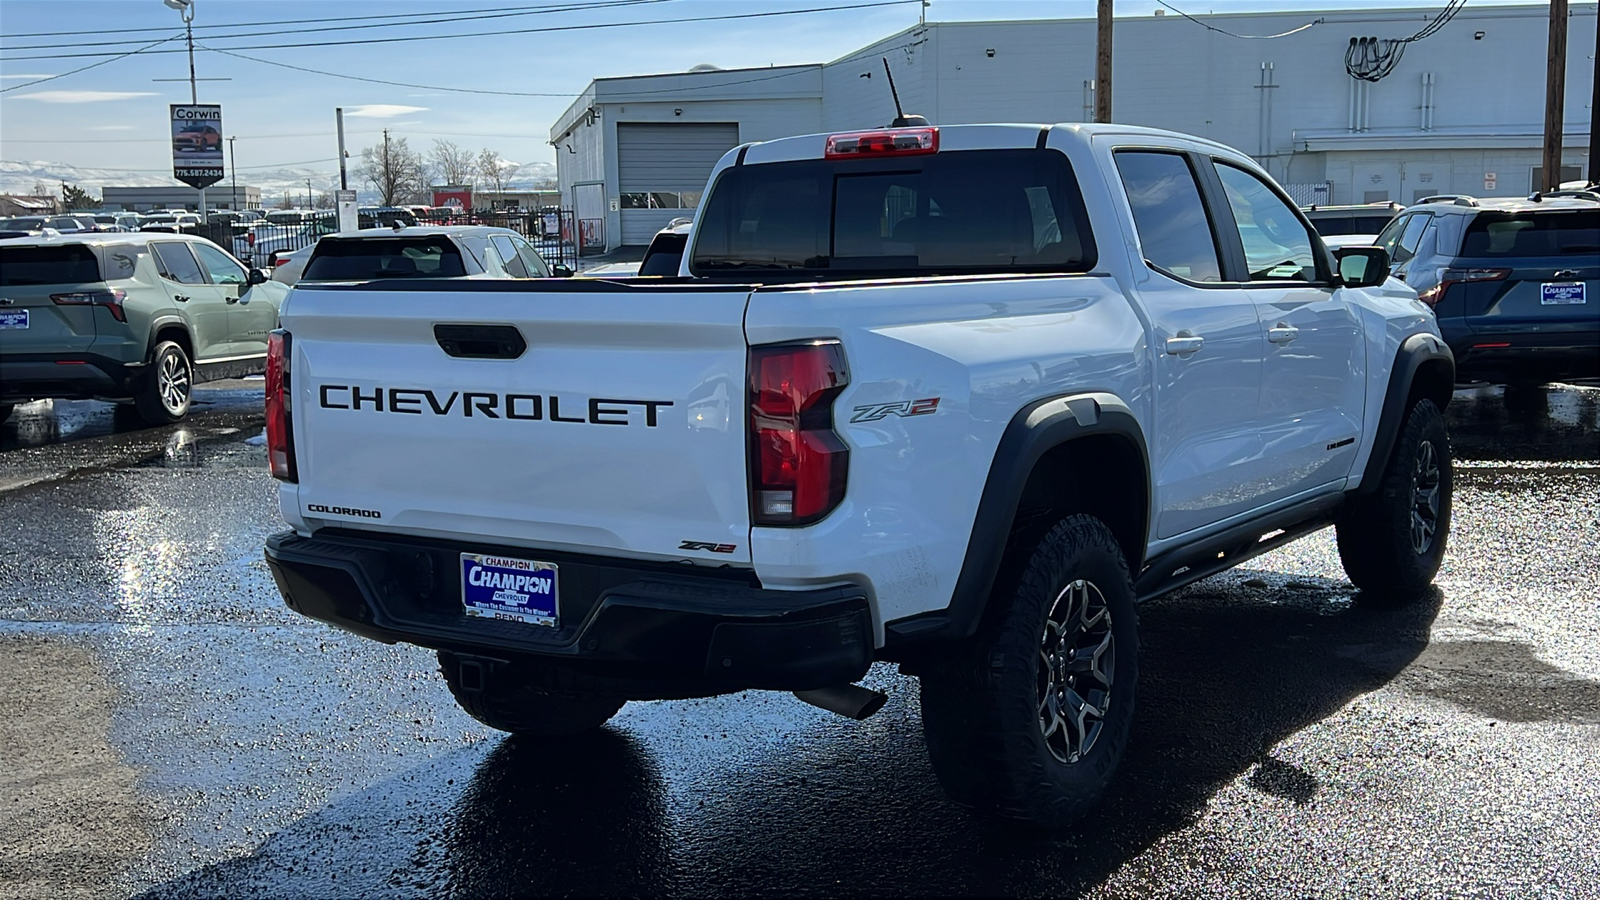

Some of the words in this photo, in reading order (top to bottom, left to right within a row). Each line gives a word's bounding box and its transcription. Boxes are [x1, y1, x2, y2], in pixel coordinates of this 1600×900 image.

[176, 108, 220, 119] Corwin
[319, 384, 674, 427] CHEVROLET
[849, 397, 941, 423] ZR2
[307, 504, 382, 518] COLORADO
[678, 540, 737, 553] ZR2
[485, 557, 530, 569] CHAMPION
[469, 566, 551, 594] CHAMPION
[494, 592, 527, 602] CHEVROLET
